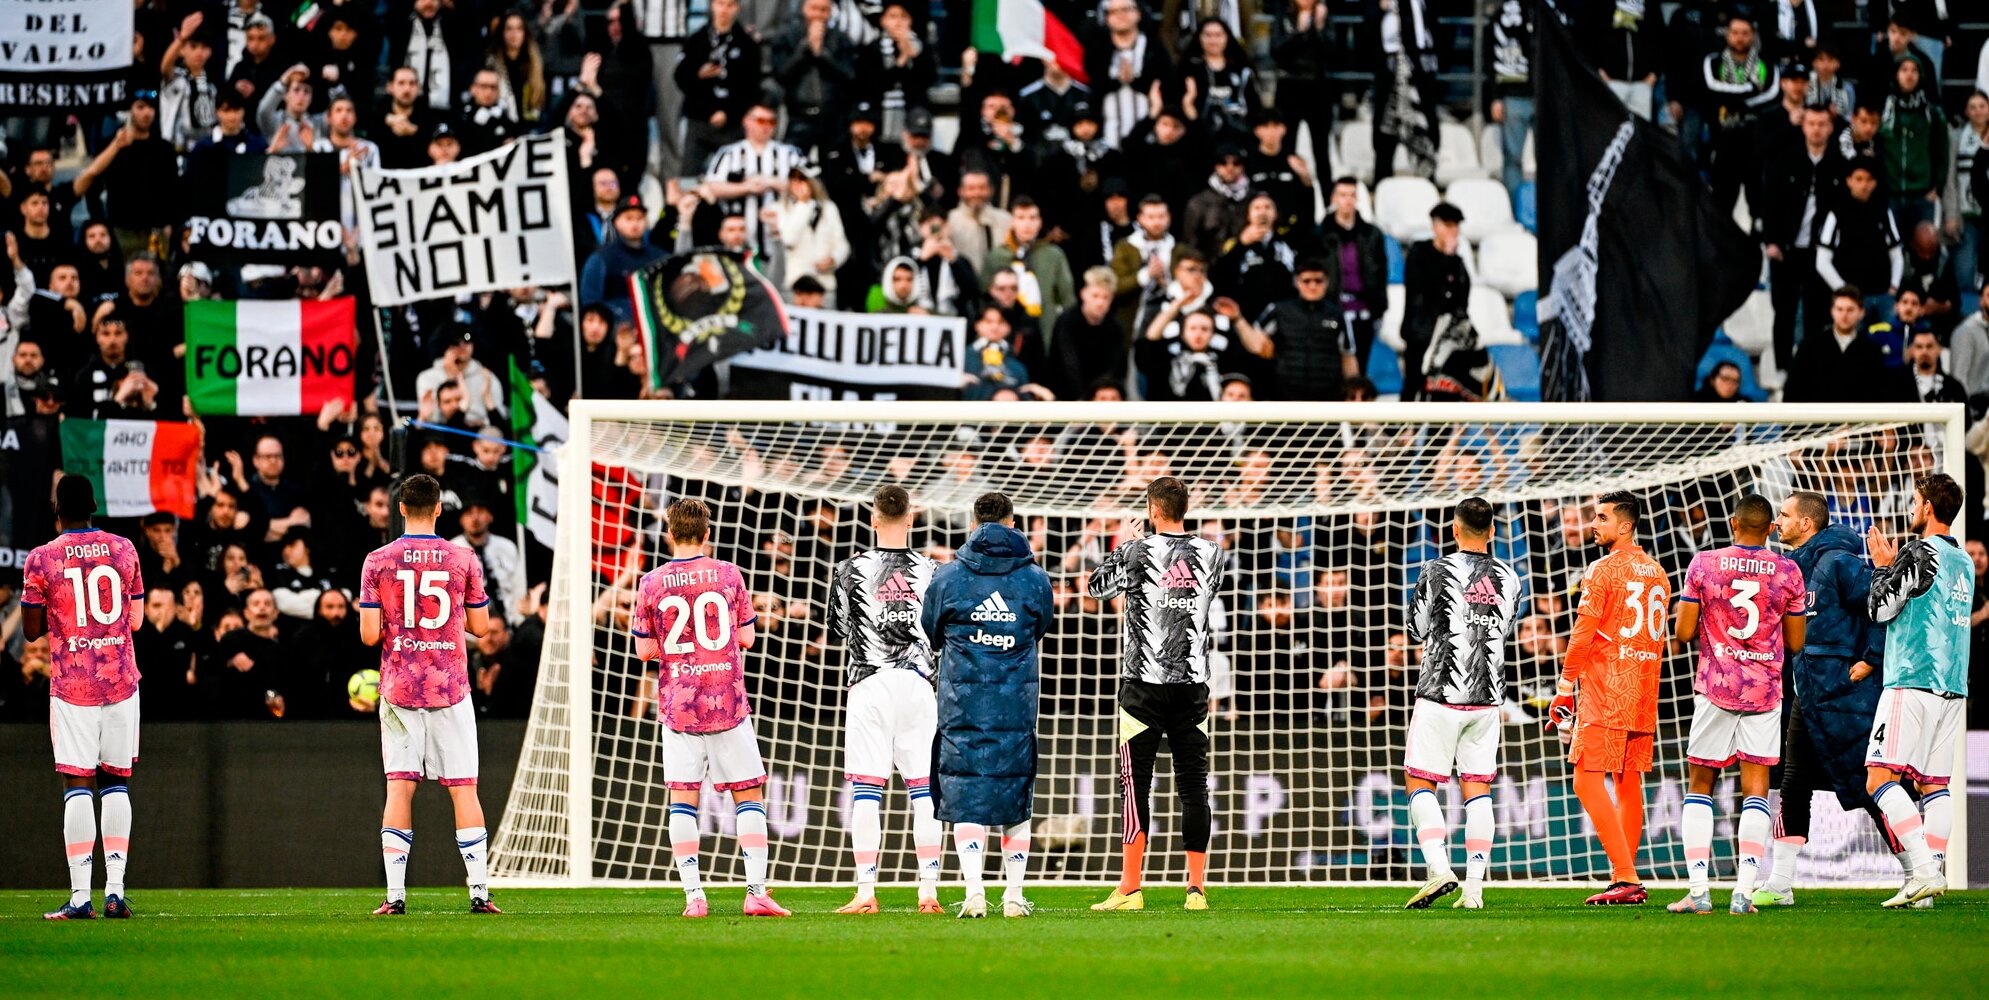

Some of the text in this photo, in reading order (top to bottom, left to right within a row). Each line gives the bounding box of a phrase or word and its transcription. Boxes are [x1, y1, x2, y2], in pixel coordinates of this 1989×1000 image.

[25, 13, 88, 33] DEL
[1, 41, 105, 63] VALLO
[370, 184, 551, 249] SIAMO
[188, 215, 342, 249] FORANO
[394, 235, 531, 297] NOI!
[855, 326, 957, 369] DELLA
[195, 343, 355, 379] FORANO
[65, 543, 111, 560] POGBA
[403, 549, 443, 563] GATTI
[1720, 556, 1776, 575] BREMER
[662, 569, 719, 589] MIRETTI
[63, 564, 123, 628] 10
[396, 569, 451, 630] 15
[875, 590, 918, 602] adidas
[1157, 593, 1196, 612] Jeep
[876, 607, 917, 625] Jeep
[970, 610, 1017, 622] adidas
[1619, 581, 1666, 642] 36
[1727, 578, 1760, 640] 3
[657, 591, 731, 655] 20
[1463, 609, 1500, 630] Jeep
[78, 636, 124, 650] Cygames
[402, 638, 456, 652] Cygames
[969, 628, 1016, 650] Jeep
[1625, 646, 1658, 661] Cygam
[1725, 646, 1775, 661] Cygames
[680, 662, 732, 676] Cygames
